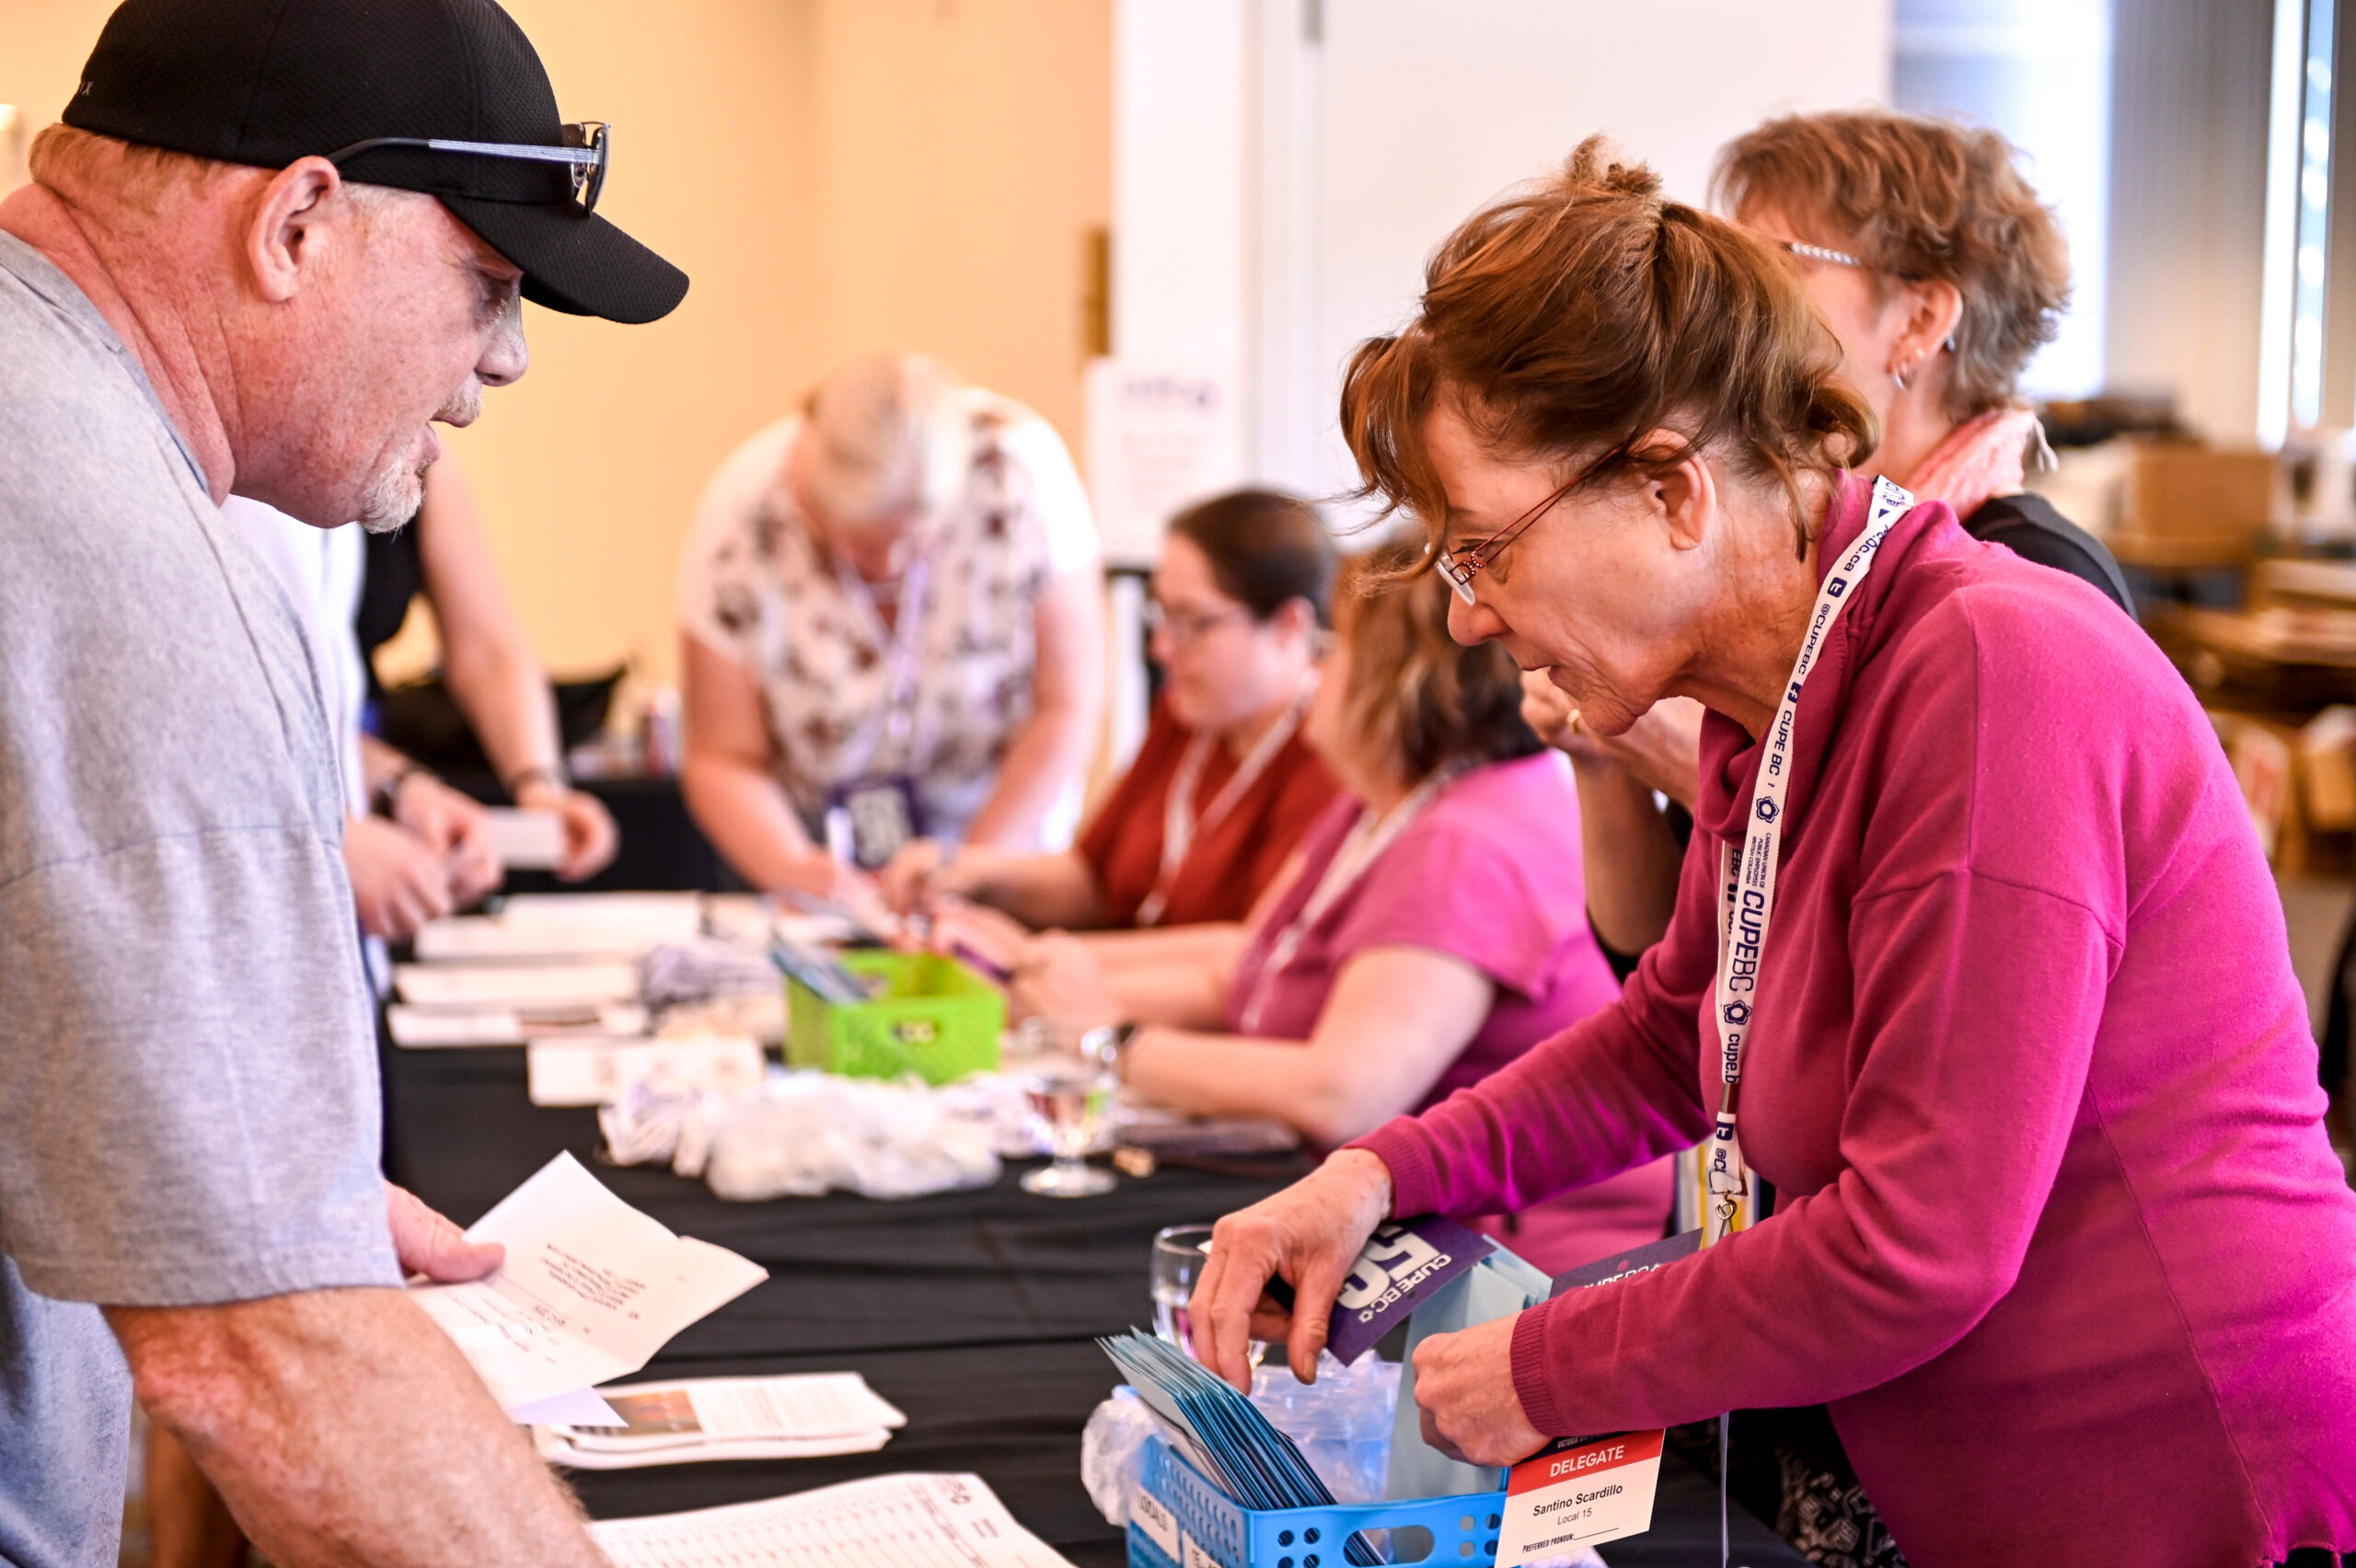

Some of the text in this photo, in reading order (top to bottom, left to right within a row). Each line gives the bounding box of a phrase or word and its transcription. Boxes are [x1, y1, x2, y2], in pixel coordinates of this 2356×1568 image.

[1798, 604, 1831, 675] @CUPEBC
[1769, 709, 1793, 777] CUPE BC
[1728, 890, 1765, 992] CUPEBC
[1550, 1445, 1625, 1478] DELEGATE
[1532, 1483, 1623, 1516] Santino Scardillo
[1557, 1507, 1592, 1526] Local 15
[1522, 1539, 1550, 1553] PREFERRED
